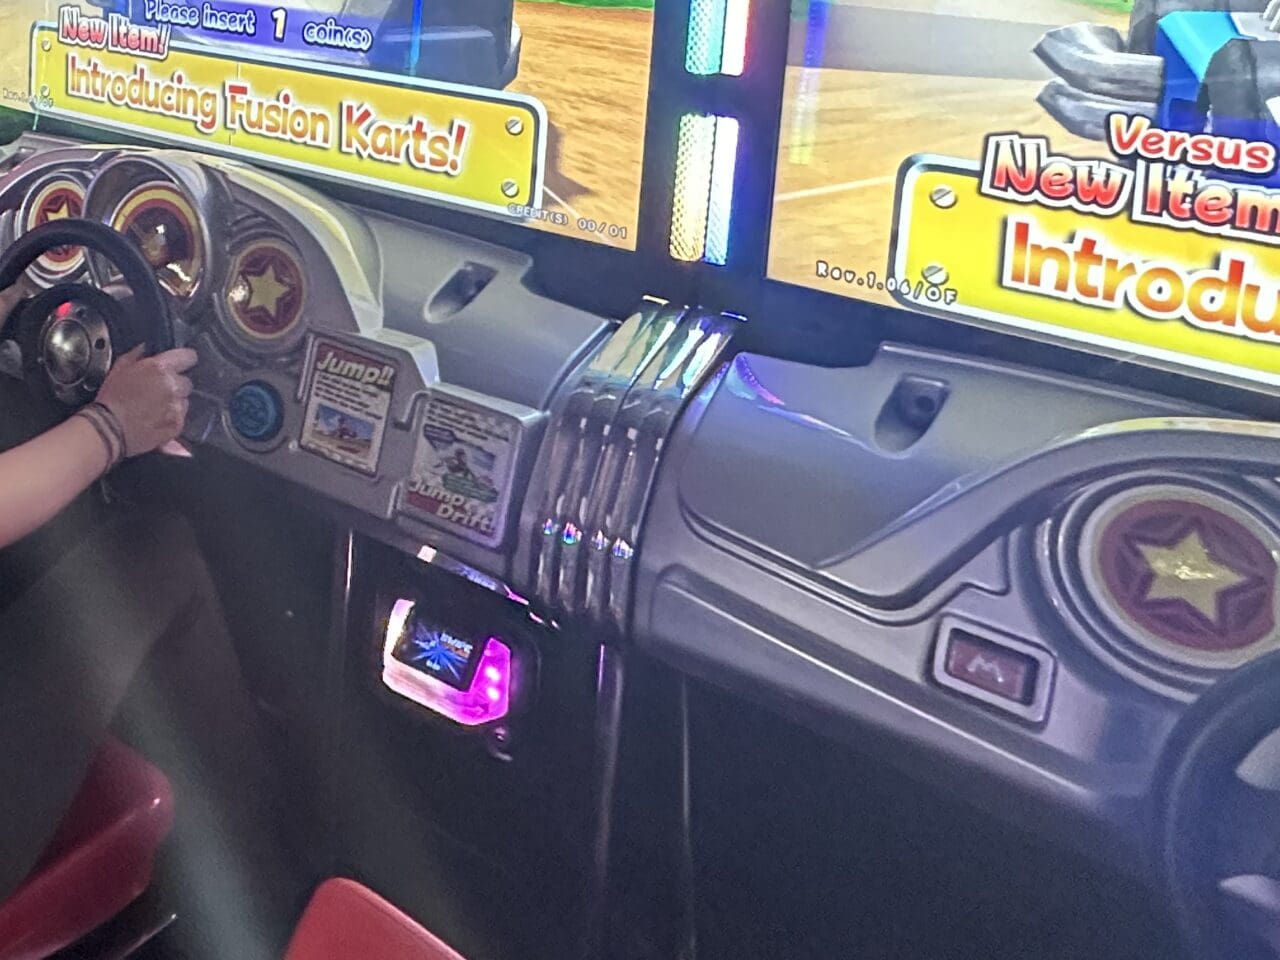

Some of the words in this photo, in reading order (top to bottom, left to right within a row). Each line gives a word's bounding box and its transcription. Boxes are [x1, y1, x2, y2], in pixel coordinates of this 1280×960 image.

[61, 9, 108, 46] New
[110, 15, 169, 55] Item!
[202, 4, 257, 36] insert
[272, 8, 287, 42] 1
[304, 21, 373, 50] coin(s)
[67, 54, 218, 131] Introducing
[227, 84, 330, 145] Fusion
[345, 104, 466, 172] Karts!
[1109, 113, 1276, 170] Versus
[992, 138, 1128, 207] New
[508, 203, 568, 225] CREDIT(S)
[1010, 221, 1280, 336] Introdu
[317, 351, 396, 386] Jump!!
